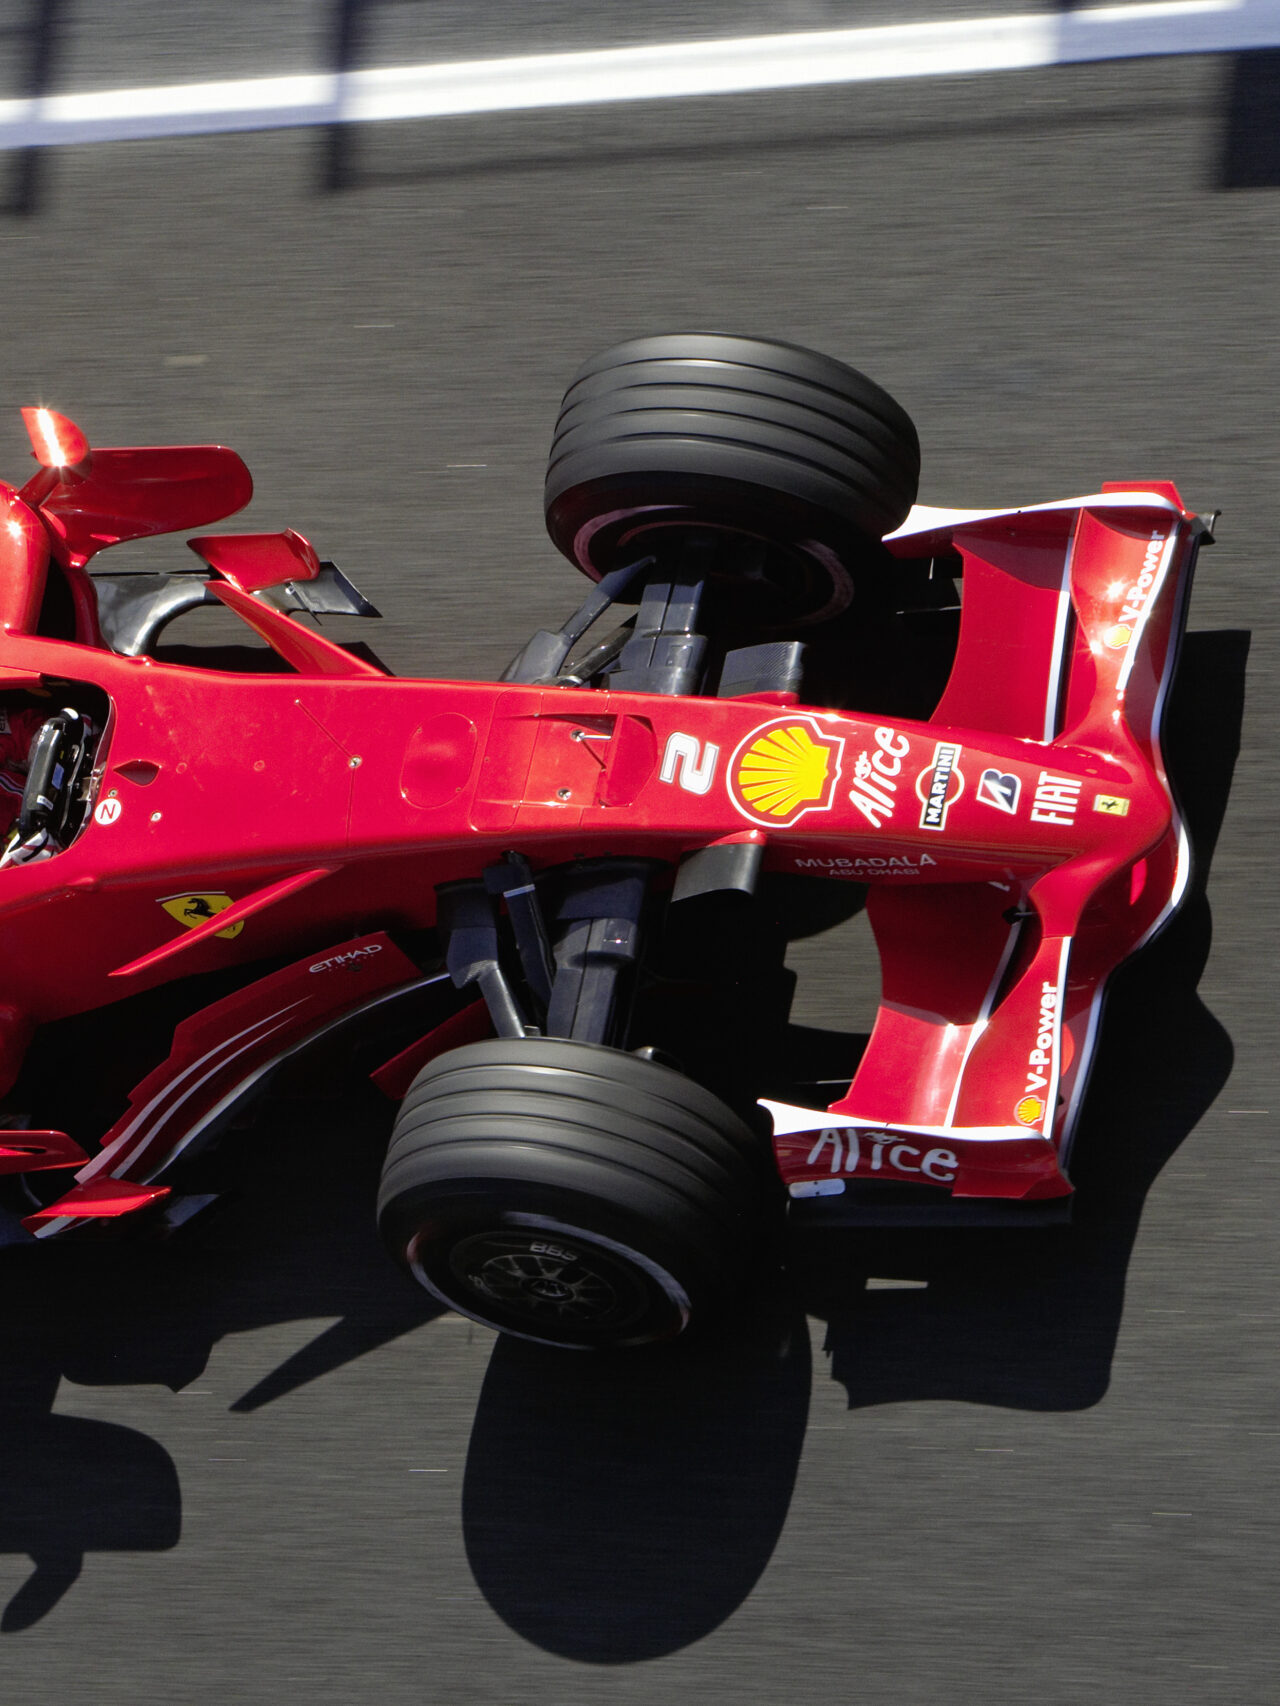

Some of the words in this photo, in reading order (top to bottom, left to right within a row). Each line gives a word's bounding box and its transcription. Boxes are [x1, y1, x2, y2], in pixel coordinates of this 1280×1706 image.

[1118, 530, 1165, 622] V-Power
[659, 731, 719, 795] 2
[848, 726, 910, 829] Alice
[925, 749, 955, 824] MARTINI
[1030, 771, 1082, 826] FIAT
[795, 853, 937, 868] MUBADALA
[829, 868, 863, 876] ABU
[867, 868, 920, 876] DHABI
[309, 944, 382, 973] ETIHAD
[1025, 981, 1058, 1092] V-Power
[807, 1127, 959, 1181] Alice
